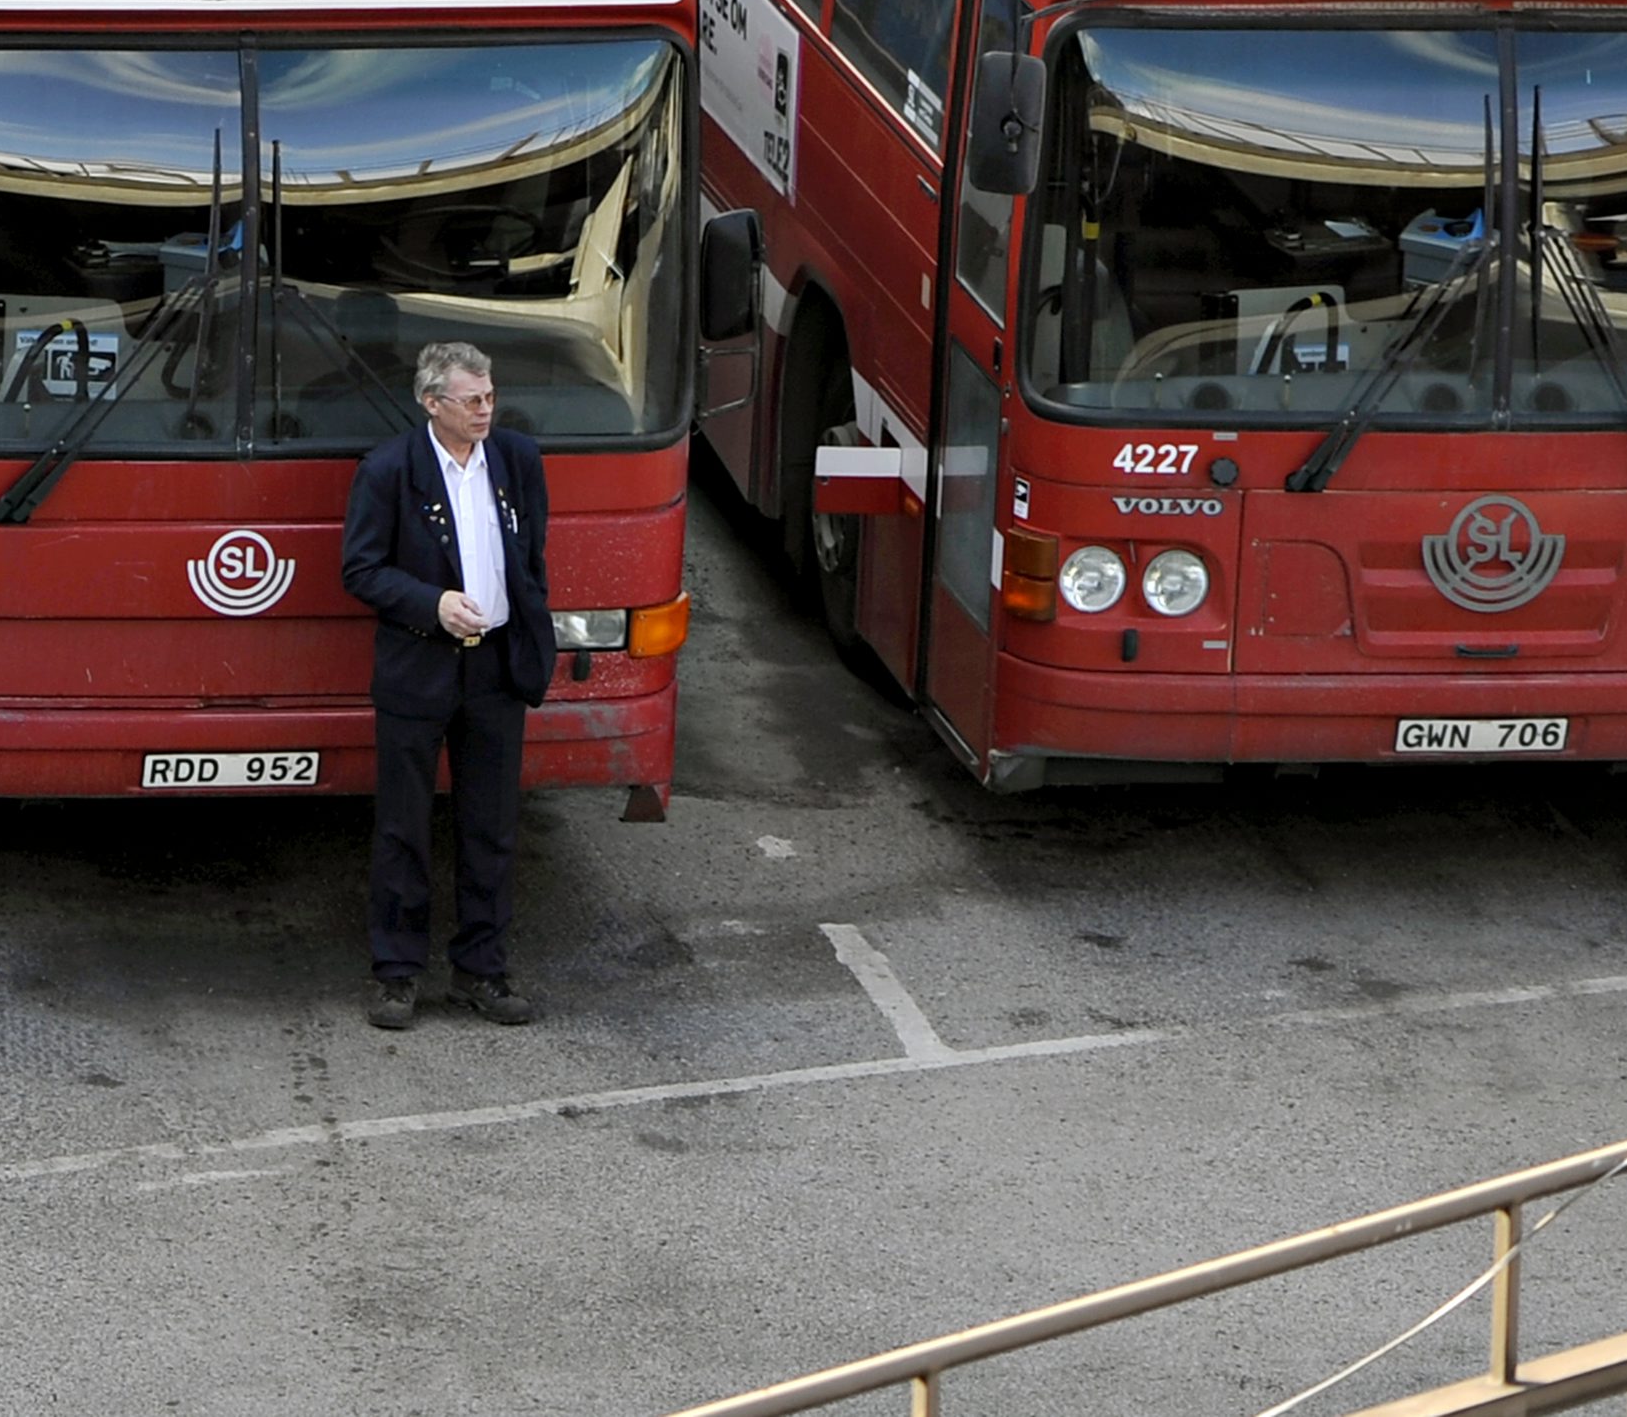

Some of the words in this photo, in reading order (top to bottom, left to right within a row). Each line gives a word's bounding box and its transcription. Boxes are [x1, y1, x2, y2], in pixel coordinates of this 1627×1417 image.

[1113, 444, 1199, 475] 4227
[1113, 496, 1223, 516] VOLVO
[1467, 509, 1523, 563] SL
[219, 546, 267, 580] SL
[1402, 724, 1471, 750] GWN
[1498, 722, 1561, 748] 706
[149, 755, 220, 783] RDD
[245, 754, 315, 783] 952
